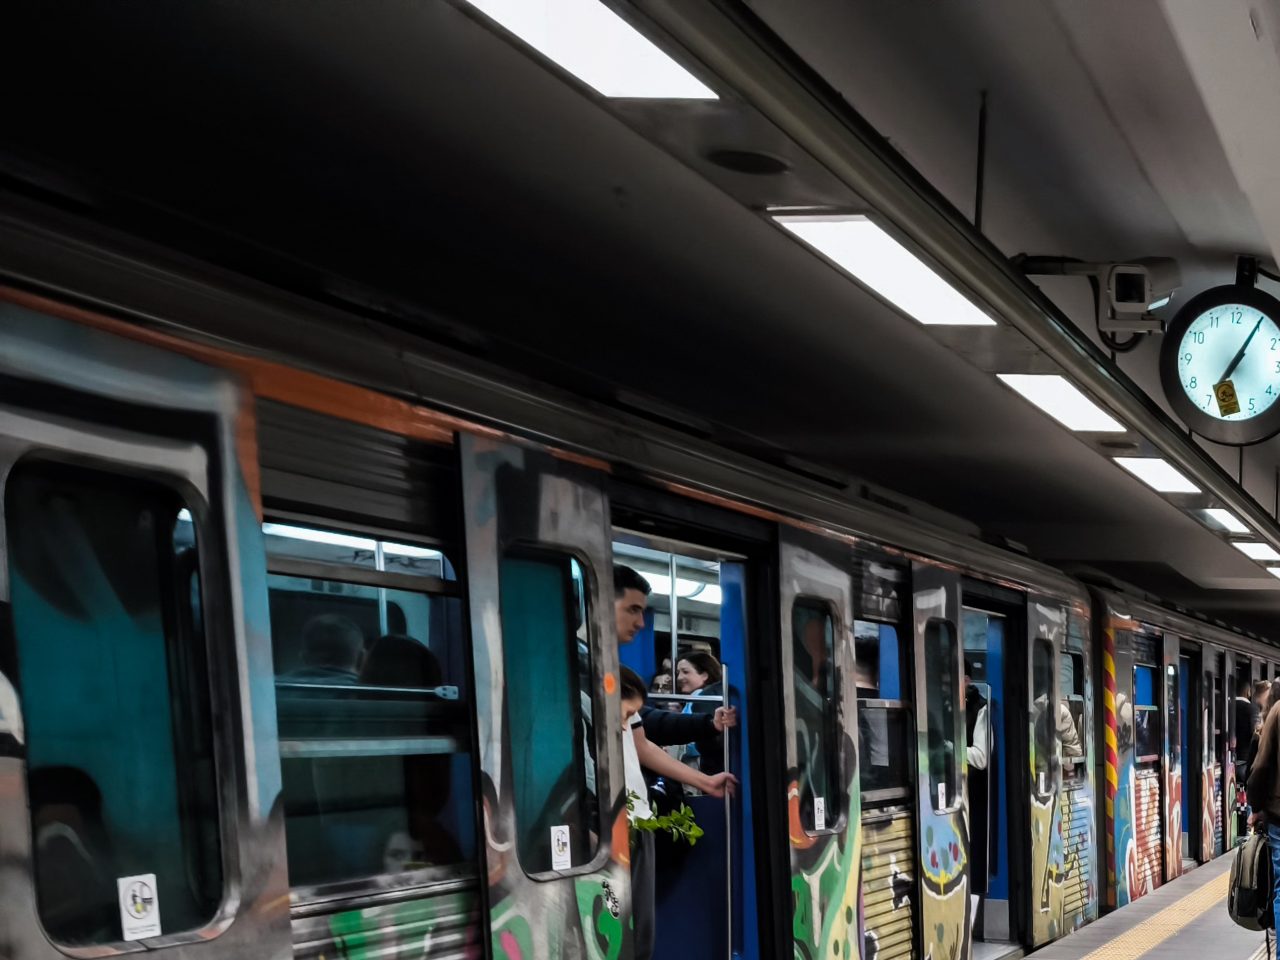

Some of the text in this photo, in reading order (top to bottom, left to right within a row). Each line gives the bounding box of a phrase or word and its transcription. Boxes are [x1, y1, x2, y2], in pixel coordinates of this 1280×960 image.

[1210, 316, 1219, 329] 11
[1231, 311, 1243, 324] 12
[1193, 331, 1205, 344] 10
[1270, 337, 1277, 351] 2
[1184, 352, 1193, 365] 9
[1189, 376, 1197, 389] 8
[1265, 384, 1272, 395] 4
[1206, 394, 1212, 406] 7
[1248, 397, 1255, 411] 5
